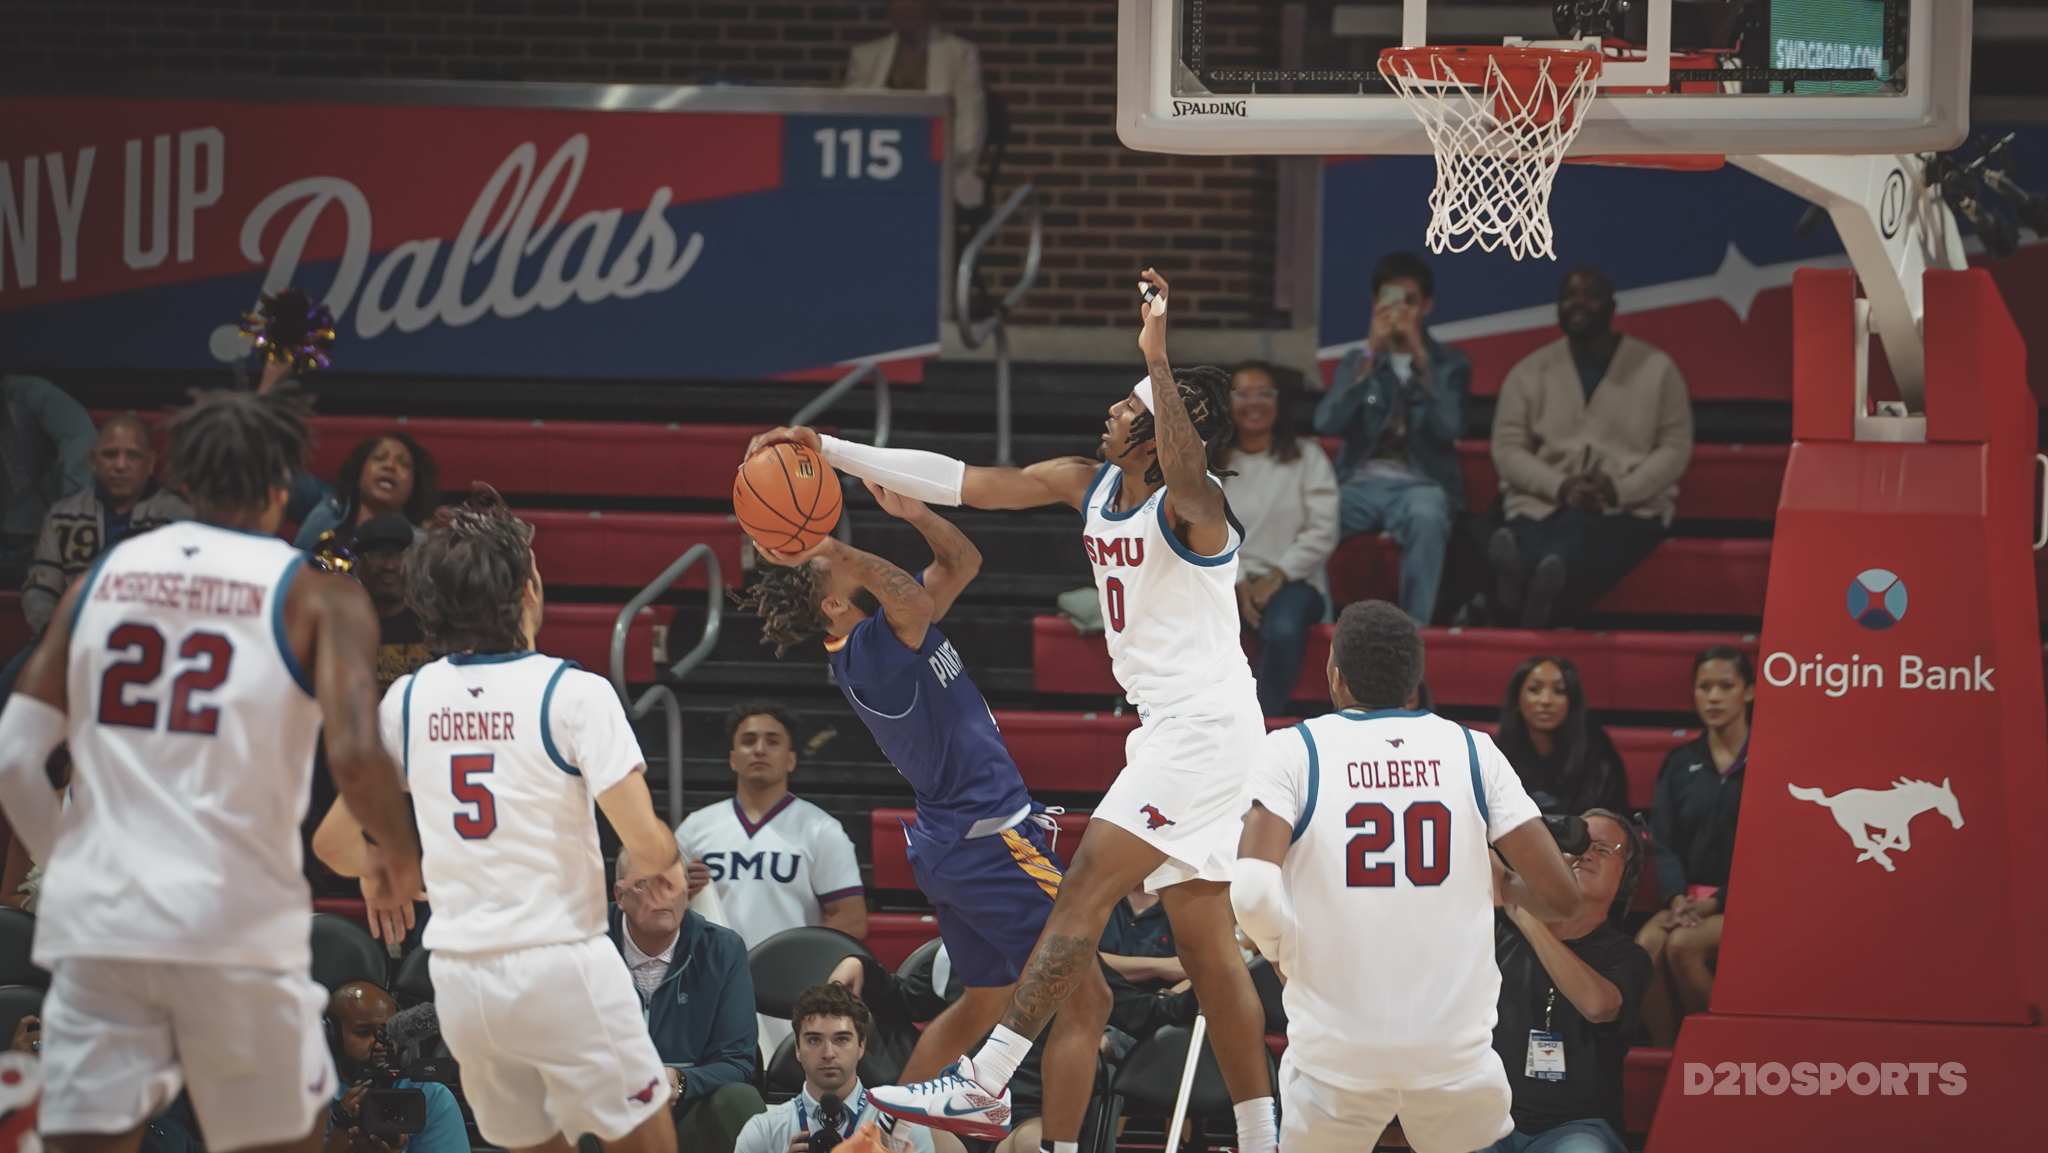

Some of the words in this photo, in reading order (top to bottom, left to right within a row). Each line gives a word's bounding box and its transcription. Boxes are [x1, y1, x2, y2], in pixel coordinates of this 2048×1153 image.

[1172, 100, 1247, 117] SPALDING
[814, 128, 903, 180] 115
[124, 127, 225, 270] UP
[209, 133, 703, 363] Dallas
[1083, 535, 1144, 567] SMU
[1106, 575, 1125, 634] 0
[98, 621, 234, 738] 22
[1763, 651, 1884, 698] Origin
[1900, 655, 1996, 692] Bank
[428, 706, 515, 742] GÖRENER
[450, 753, 497, 840] 5
[1346, 759, 1441, 788] COLBERT
[702, 850, 801, 883] SMU
[1345, 800, 1452, 888] 20
